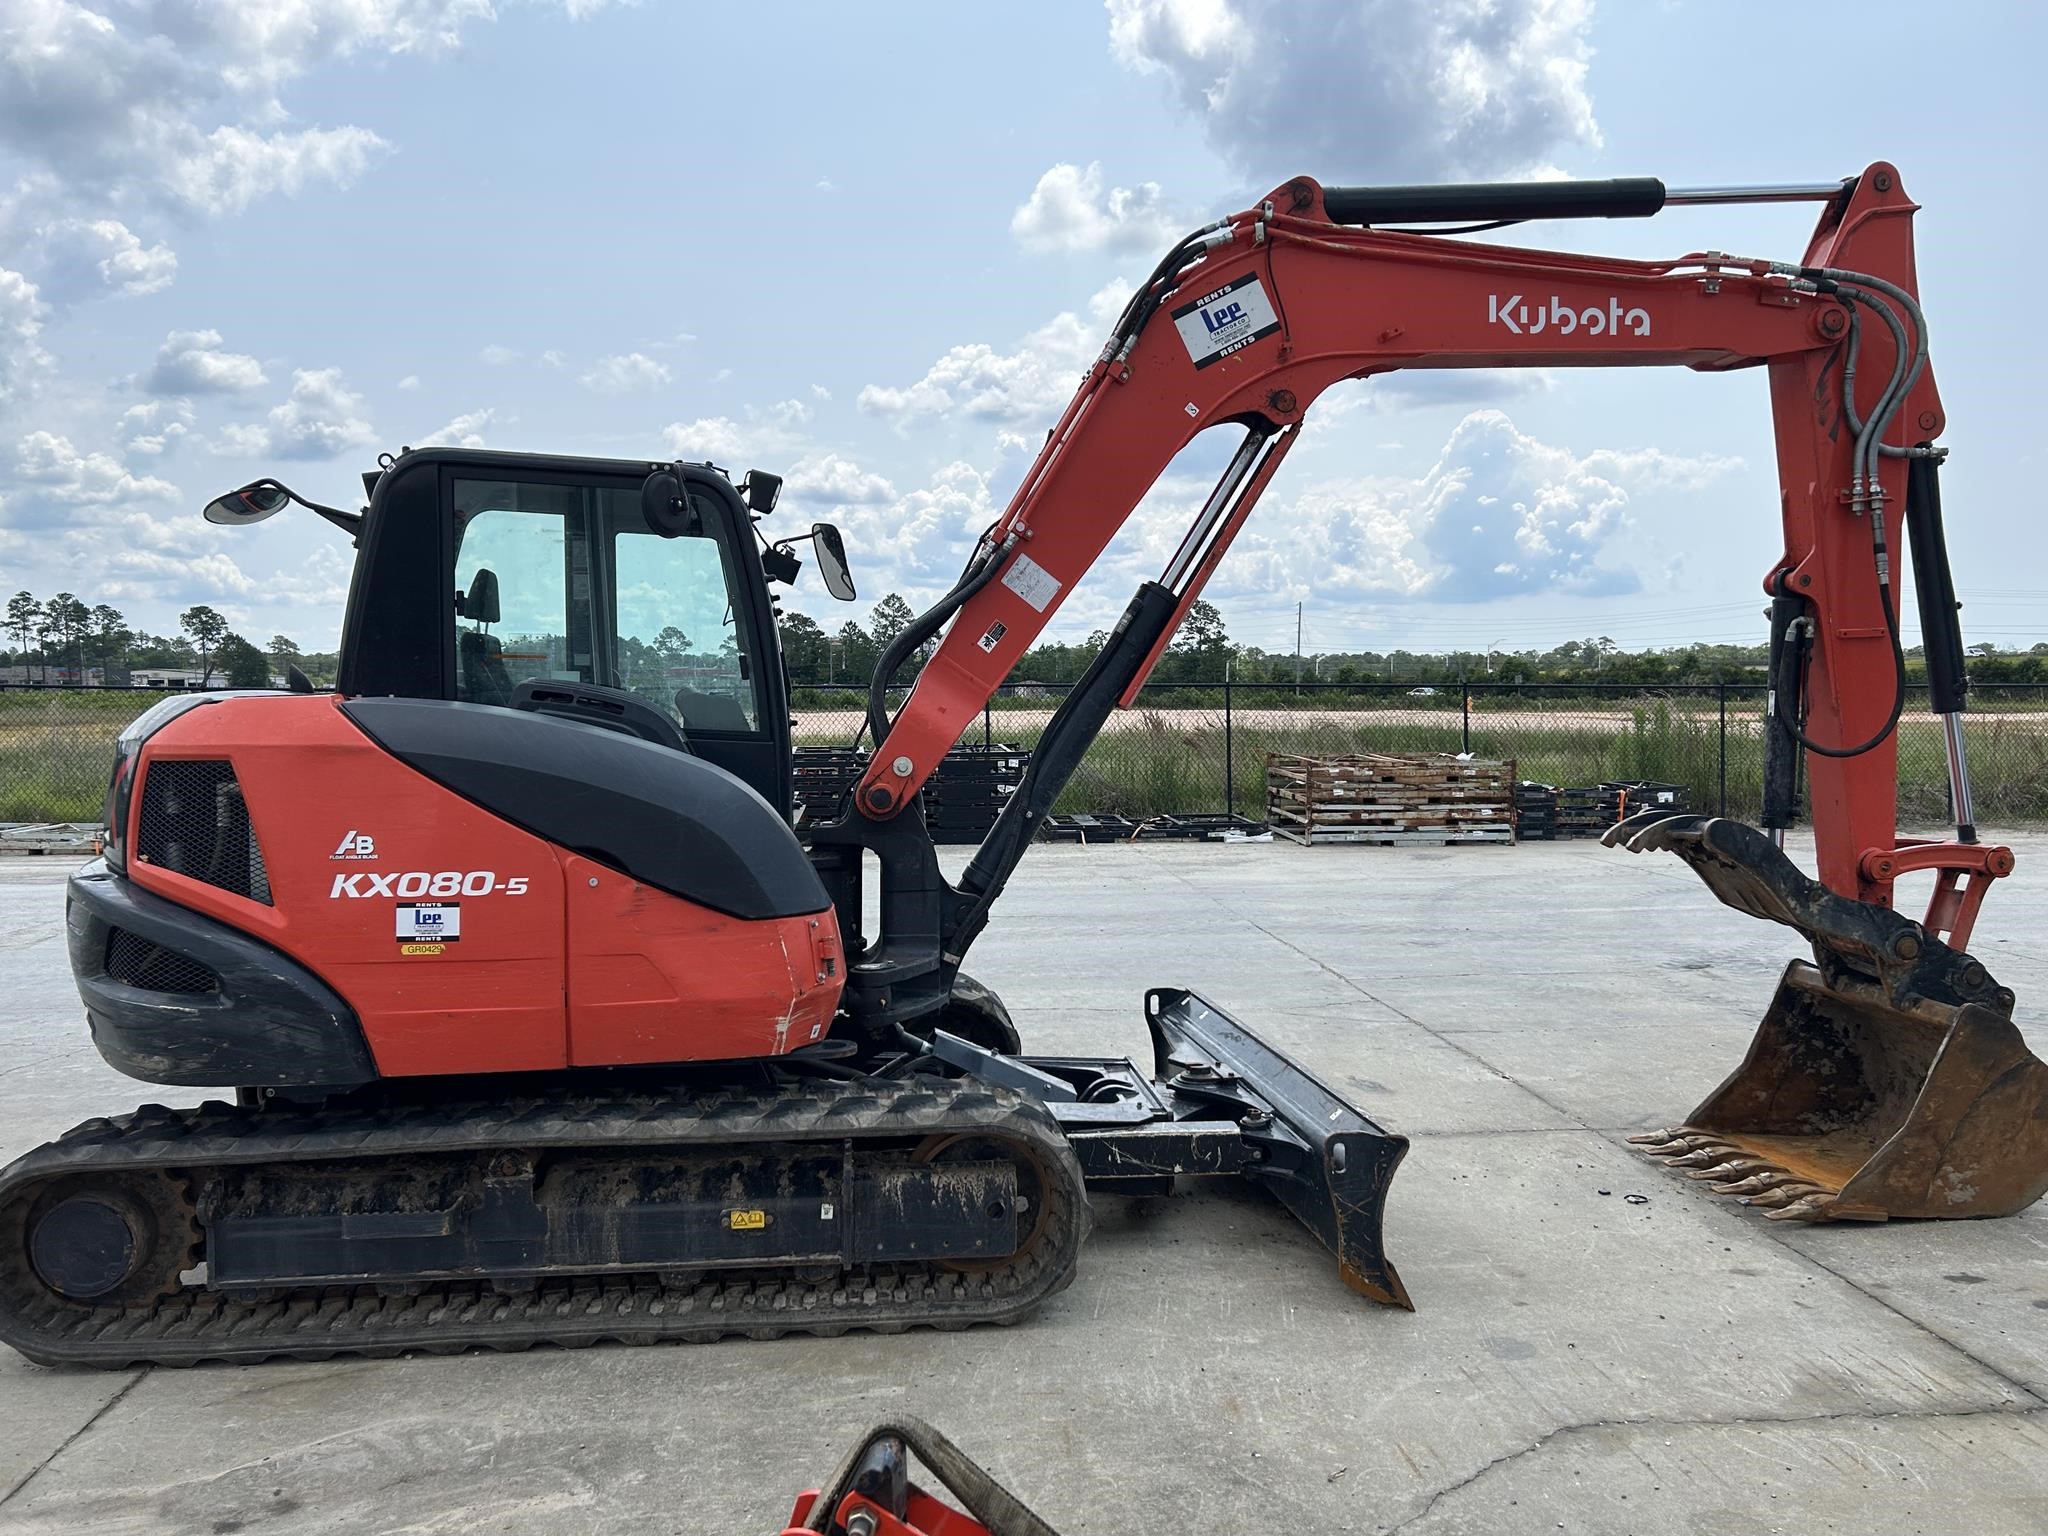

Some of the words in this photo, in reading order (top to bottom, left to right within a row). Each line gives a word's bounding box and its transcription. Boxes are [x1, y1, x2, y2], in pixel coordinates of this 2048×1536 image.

[1196, 285, 1232, 307] RENTS
[1199, 301, 1248, 334] Lee
[1489, 294, 1651, 336] Kubota
[1213, 322, 1237, 337] TRACTOR
[1219, 335, 1256, 358] RENTS
[329, 870, 530, 898] KX080-5
[415, 909, 444, 925] Lee
[407, 945, 442, 954] GR0429
